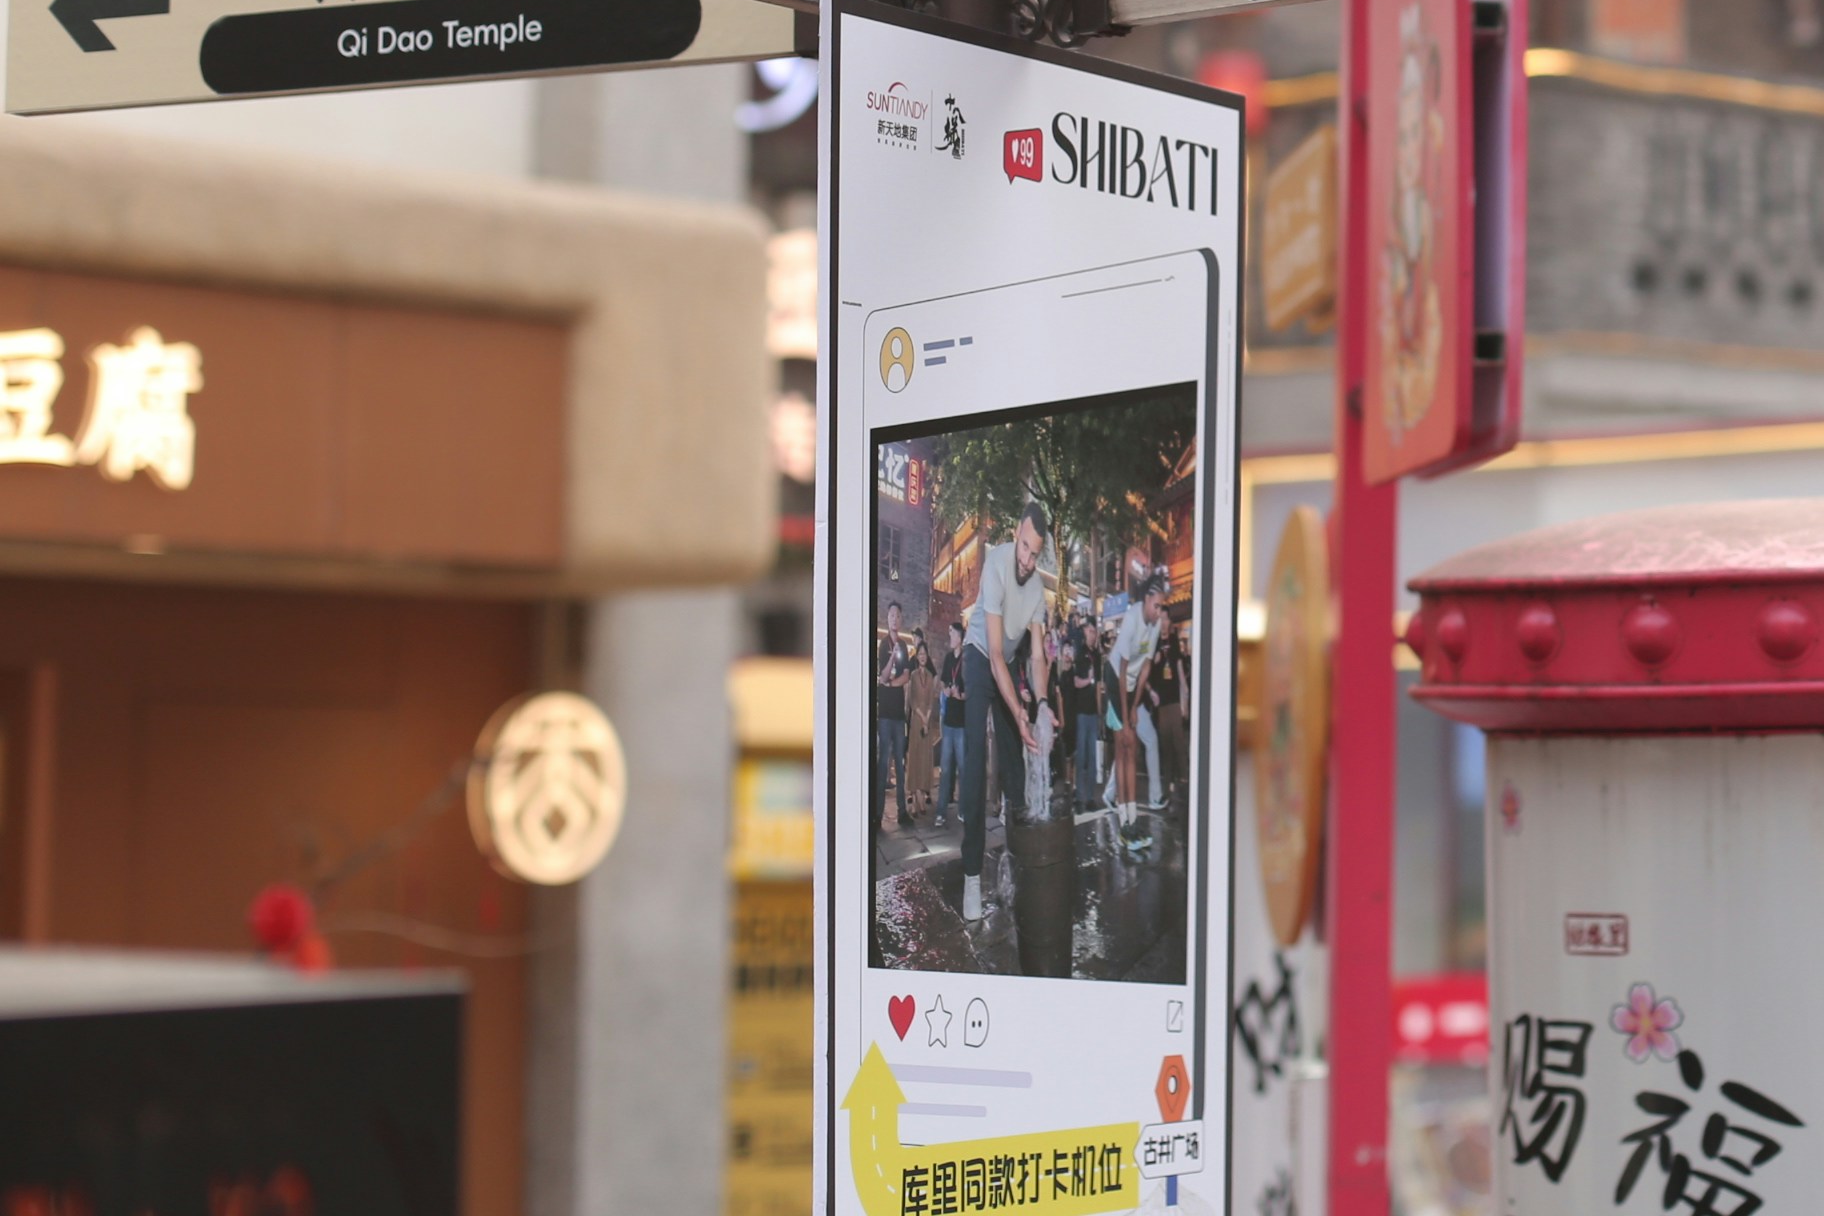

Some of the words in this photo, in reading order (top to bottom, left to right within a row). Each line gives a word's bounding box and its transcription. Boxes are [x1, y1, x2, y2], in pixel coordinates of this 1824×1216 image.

[337, 26, 369, 58] Qi
[377, 25, 433, 54] Dao
[442, 14, 543, 52] Temple
[867, 90, 928, 120] SUNTIANDY
[877, 119, 918, 142] 新天地集团
[1020, 136, 1034, 168] 99
[1051, 111, 1218, 216] SHIBATI
[1143, 1132, 1200, 1166] 古井广场
[900, 1142, 1123, 1216] 库里同款打卡机位
